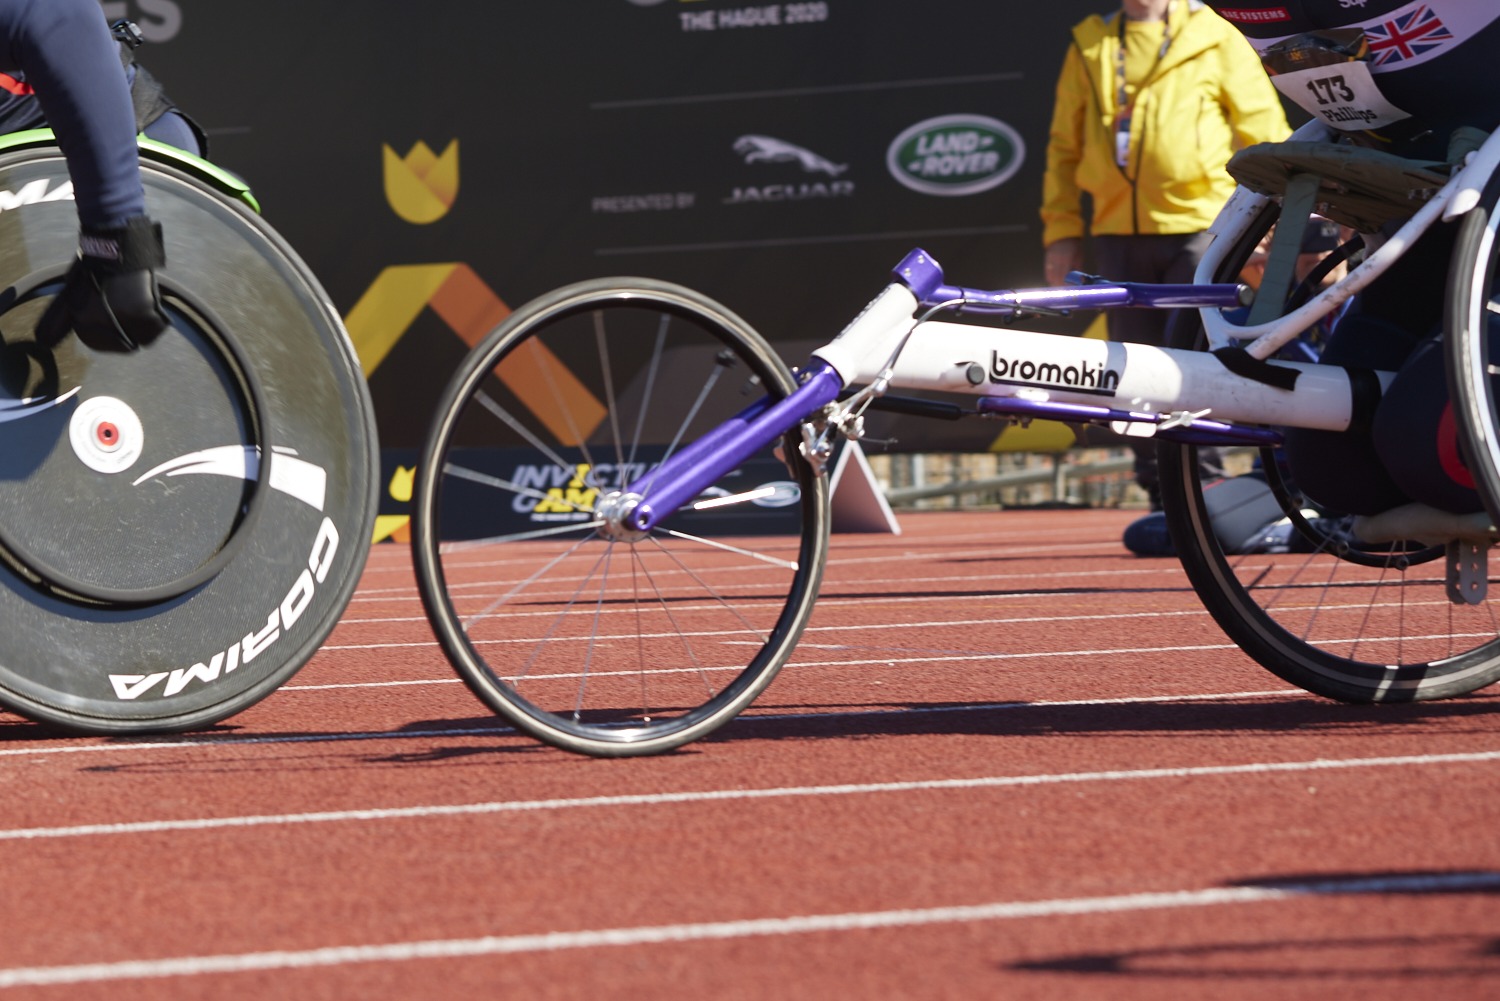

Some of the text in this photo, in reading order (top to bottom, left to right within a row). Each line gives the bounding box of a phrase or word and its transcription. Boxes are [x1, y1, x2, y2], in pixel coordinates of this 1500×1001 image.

[680, 1, 829, 31] THE HAGUE 2020
[1240, 10, 1286, 20] SYSTEMS
[1306, 75, 1355, 105] 173
[1320, 108, 1378, 124] Phillips
[916, 131, 980, 156] LAND
[922, 151, 1000, 177] ROVER
[723, 181, 855, 205] JAGUAR
[989, 349, 1120, 397] bromakin
[108, 516, 340, 700] CORIMA
